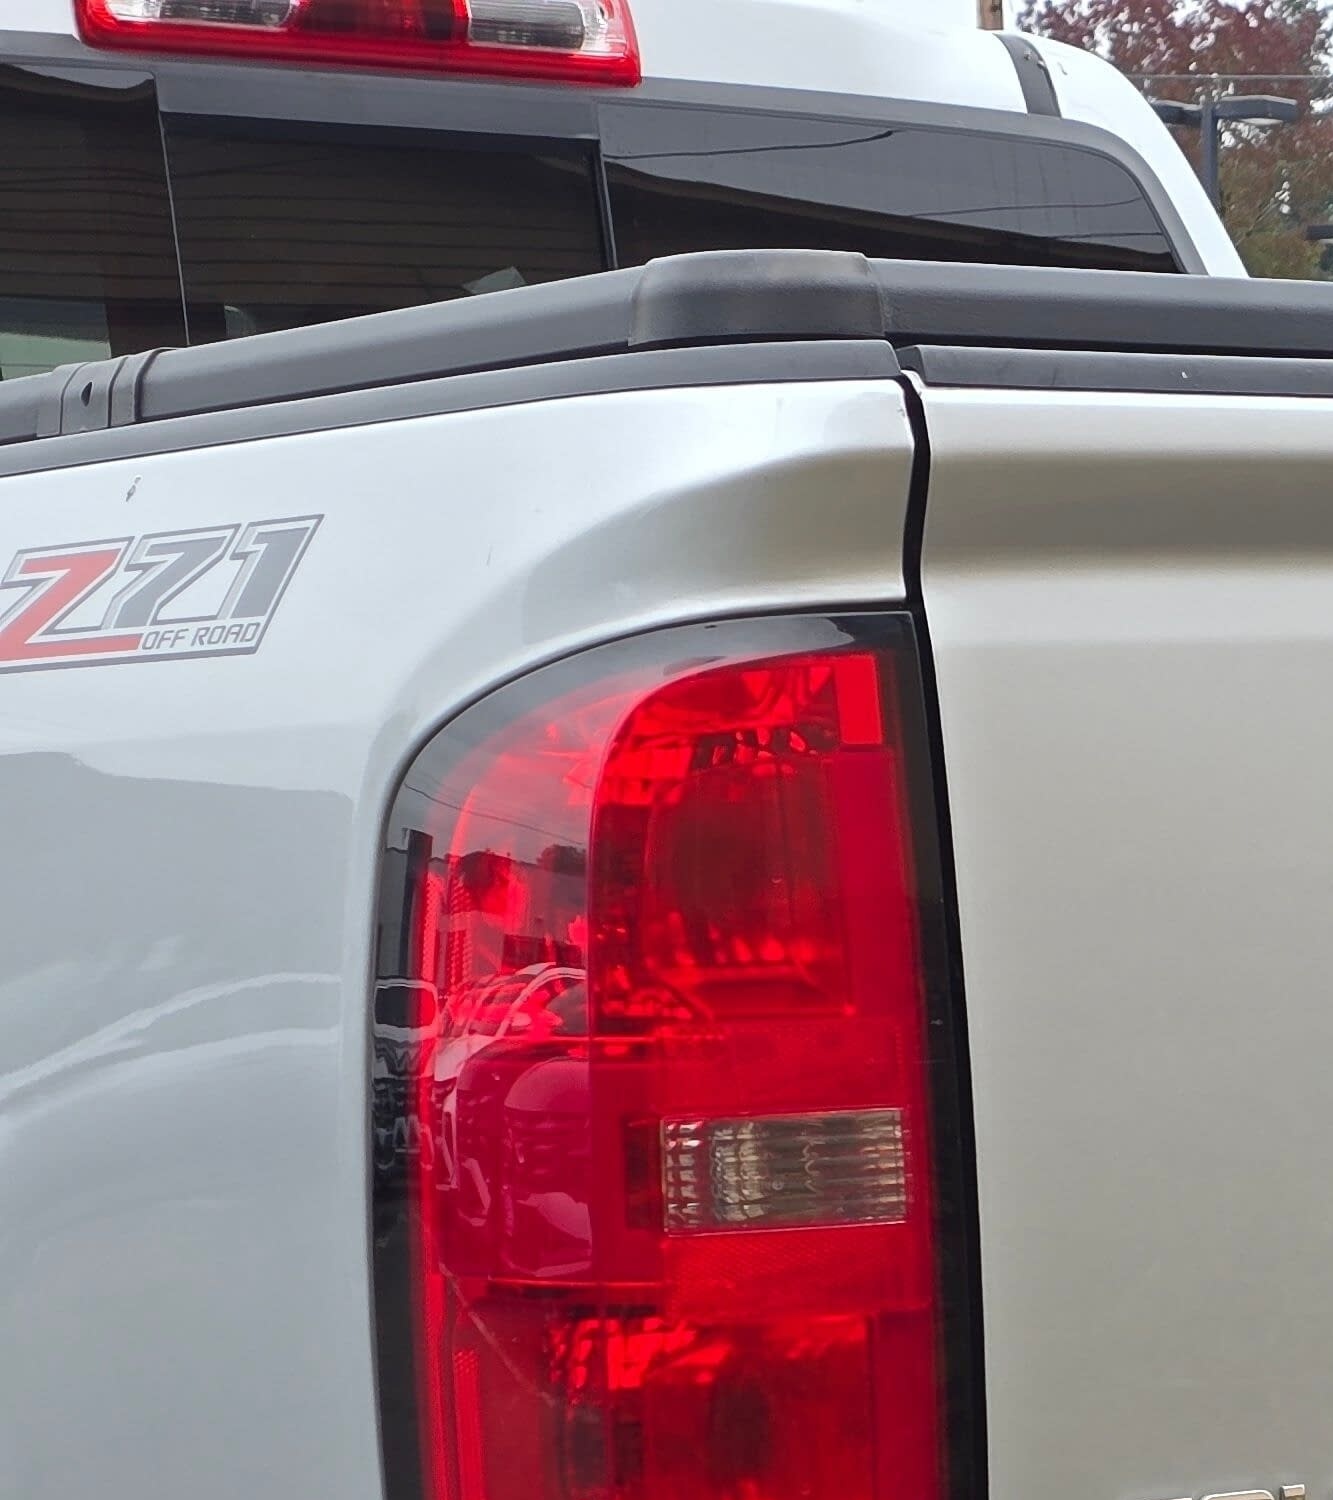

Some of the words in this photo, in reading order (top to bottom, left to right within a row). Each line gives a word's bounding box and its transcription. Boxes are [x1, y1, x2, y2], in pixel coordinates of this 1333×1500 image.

[0, 517, 320, 670] Z71
[141, 628, 189, 650] OFF
[191, 622, 261, 647] ROAD
